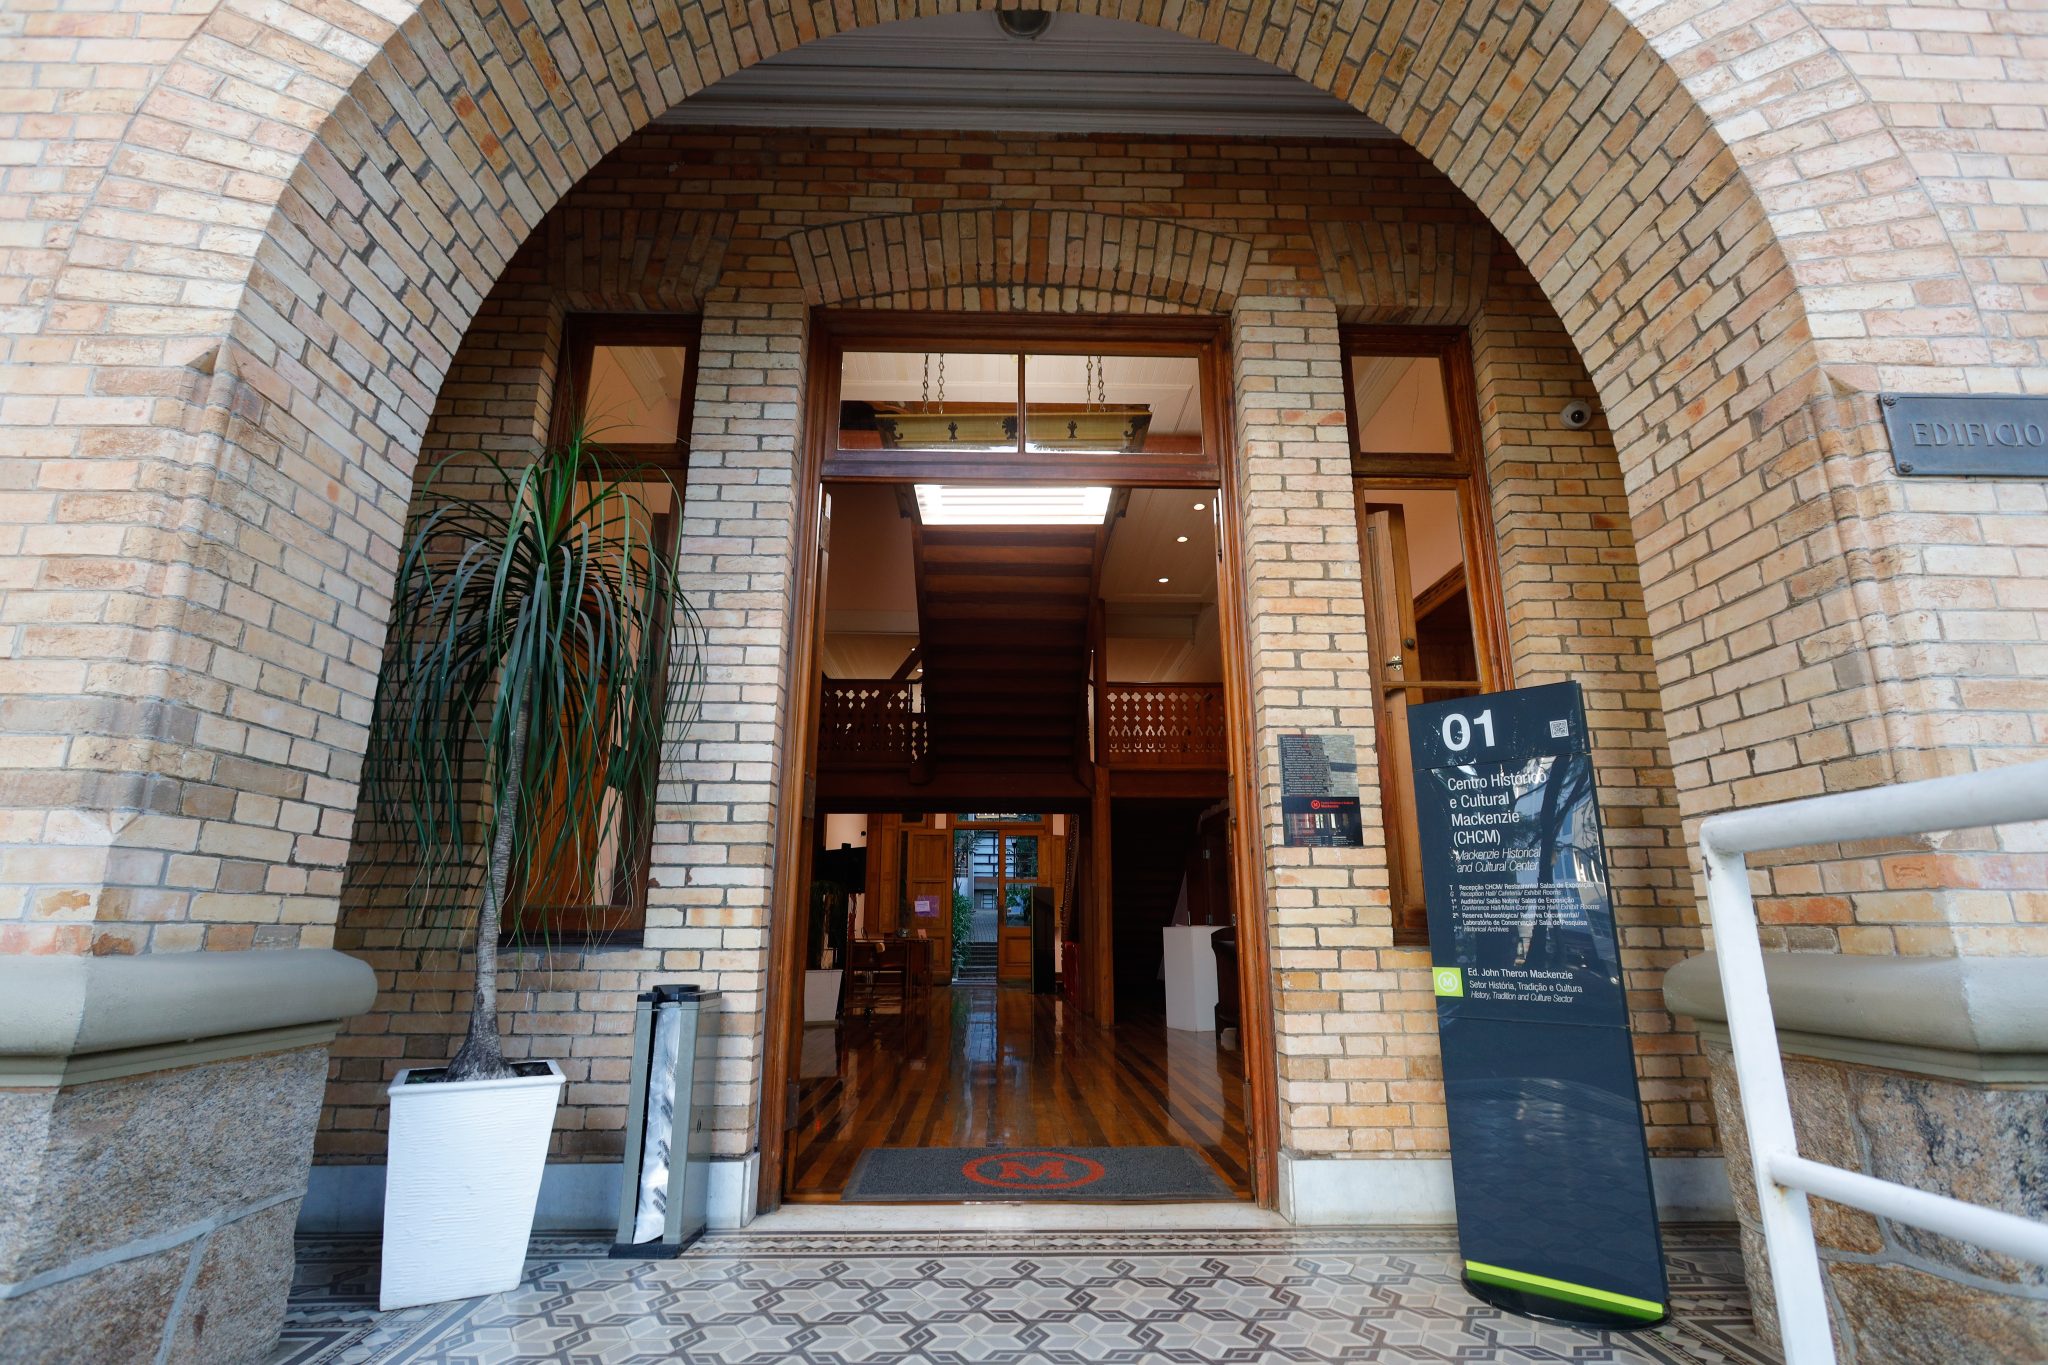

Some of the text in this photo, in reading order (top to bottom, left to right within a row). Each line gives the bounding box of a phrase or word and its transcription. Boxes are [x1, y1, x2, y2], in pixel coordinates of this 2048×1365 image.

[1909, 422, 2045, 447] EDIFICIO
[1442, 709, 1495, 751] 01
[1448, 771, 1547, 791] Centro Histórico
[1450, 792, 1510, 808] e Cultural
[1451, 810, 1520, 826] Mackenzie
[1453, 829, 1501, 847] (CHCM)
[1457, 847, 1542, 860] Mackenzie Historical
[1456, 860, 1539, 873] and Cultural Center
[1468, 967, 1574, 980] Ed. John Theron Mackenzie
[1469, 980, 1488, 989] Setor
[1489, 981, 1517, 991] História,
[1517, 982, 1548, 994] Tradição
[1556, 984, 1583, 993] Cultura
[1470, 990, 1574, 1004] History, Tradition and Culture Sector
